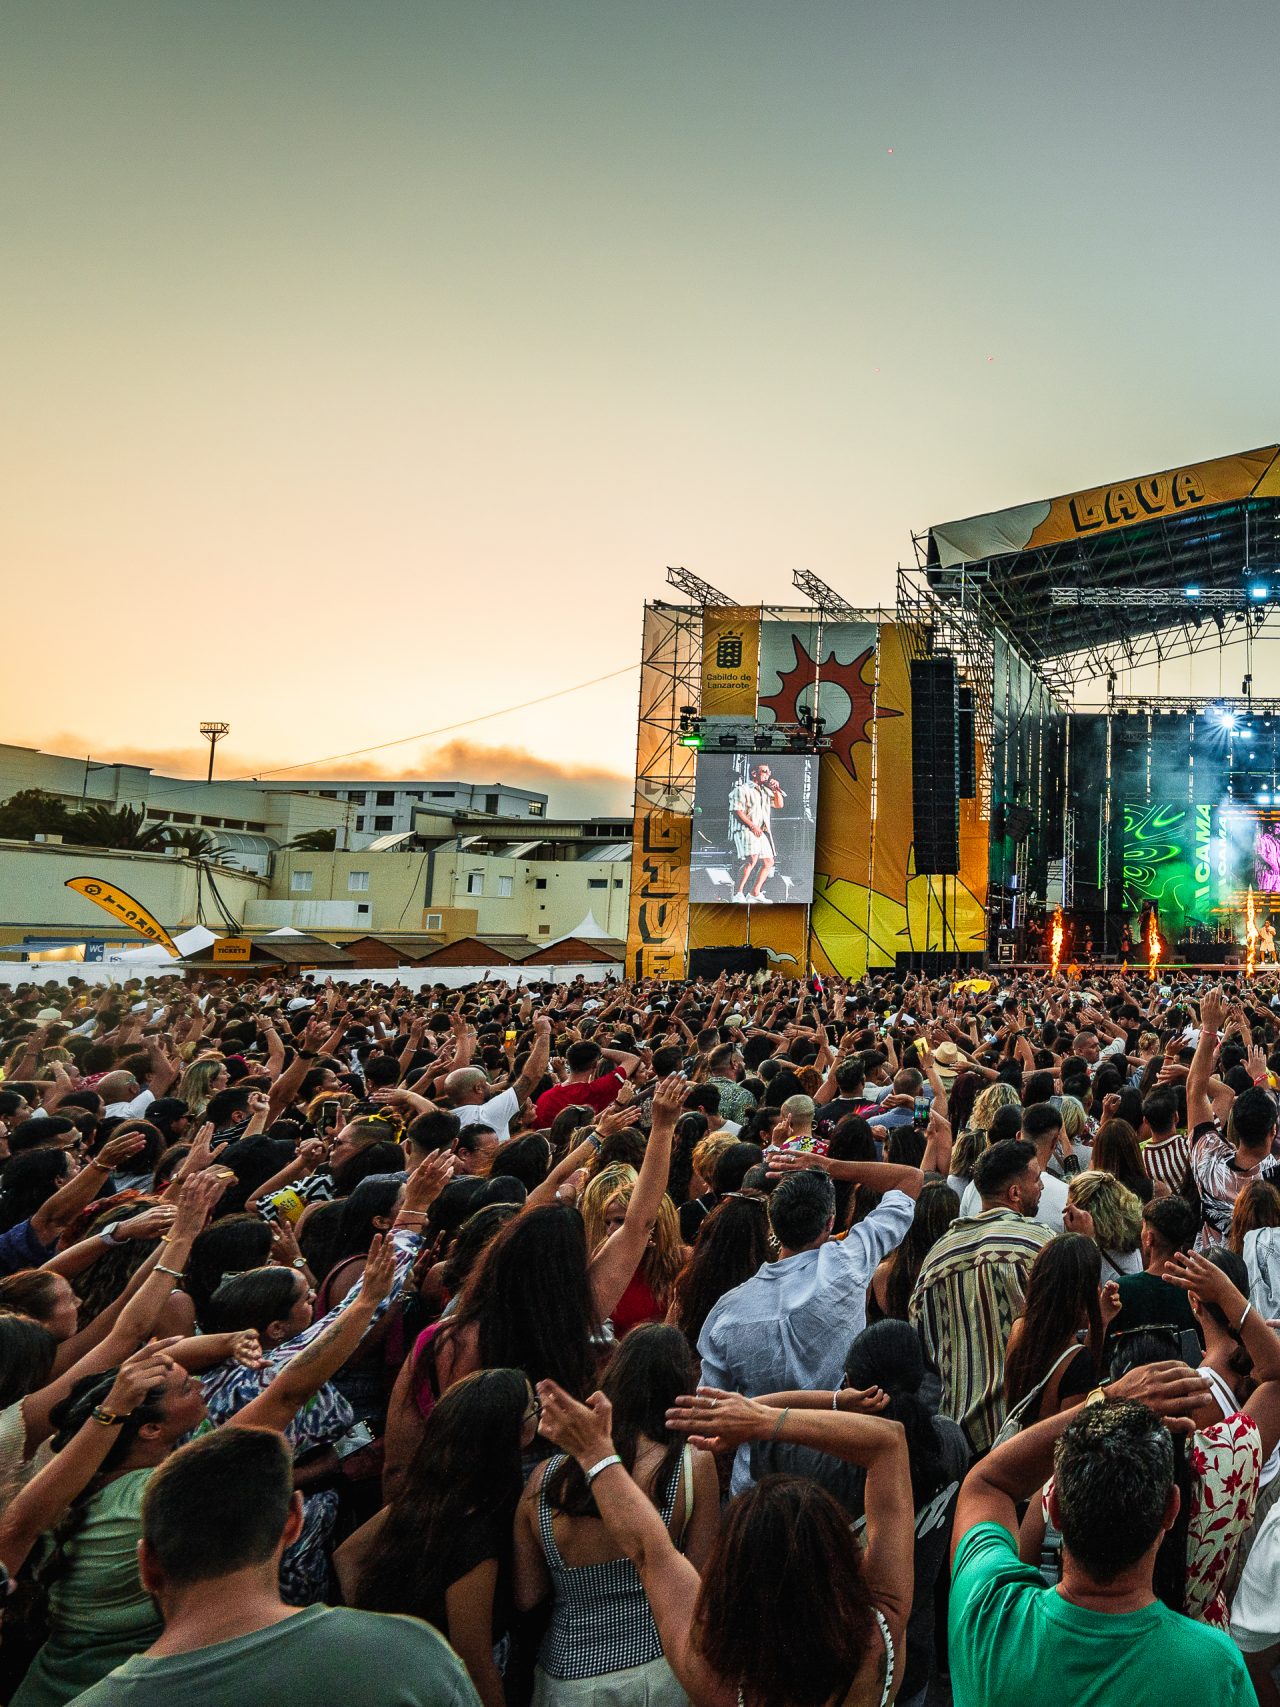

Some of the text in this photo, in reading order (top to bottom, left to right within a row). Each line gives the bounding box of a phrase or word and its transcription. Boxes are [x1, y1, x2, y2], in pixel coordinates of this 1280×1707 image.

[1068, 469, 1206, 532] LAVA
[706, 673, 752, 681] Cabildo de
[1194, 804, 1211, 883] CAMA
[636, 812, 682, 980] LIVE
[89, 944, 104, 953] WC
